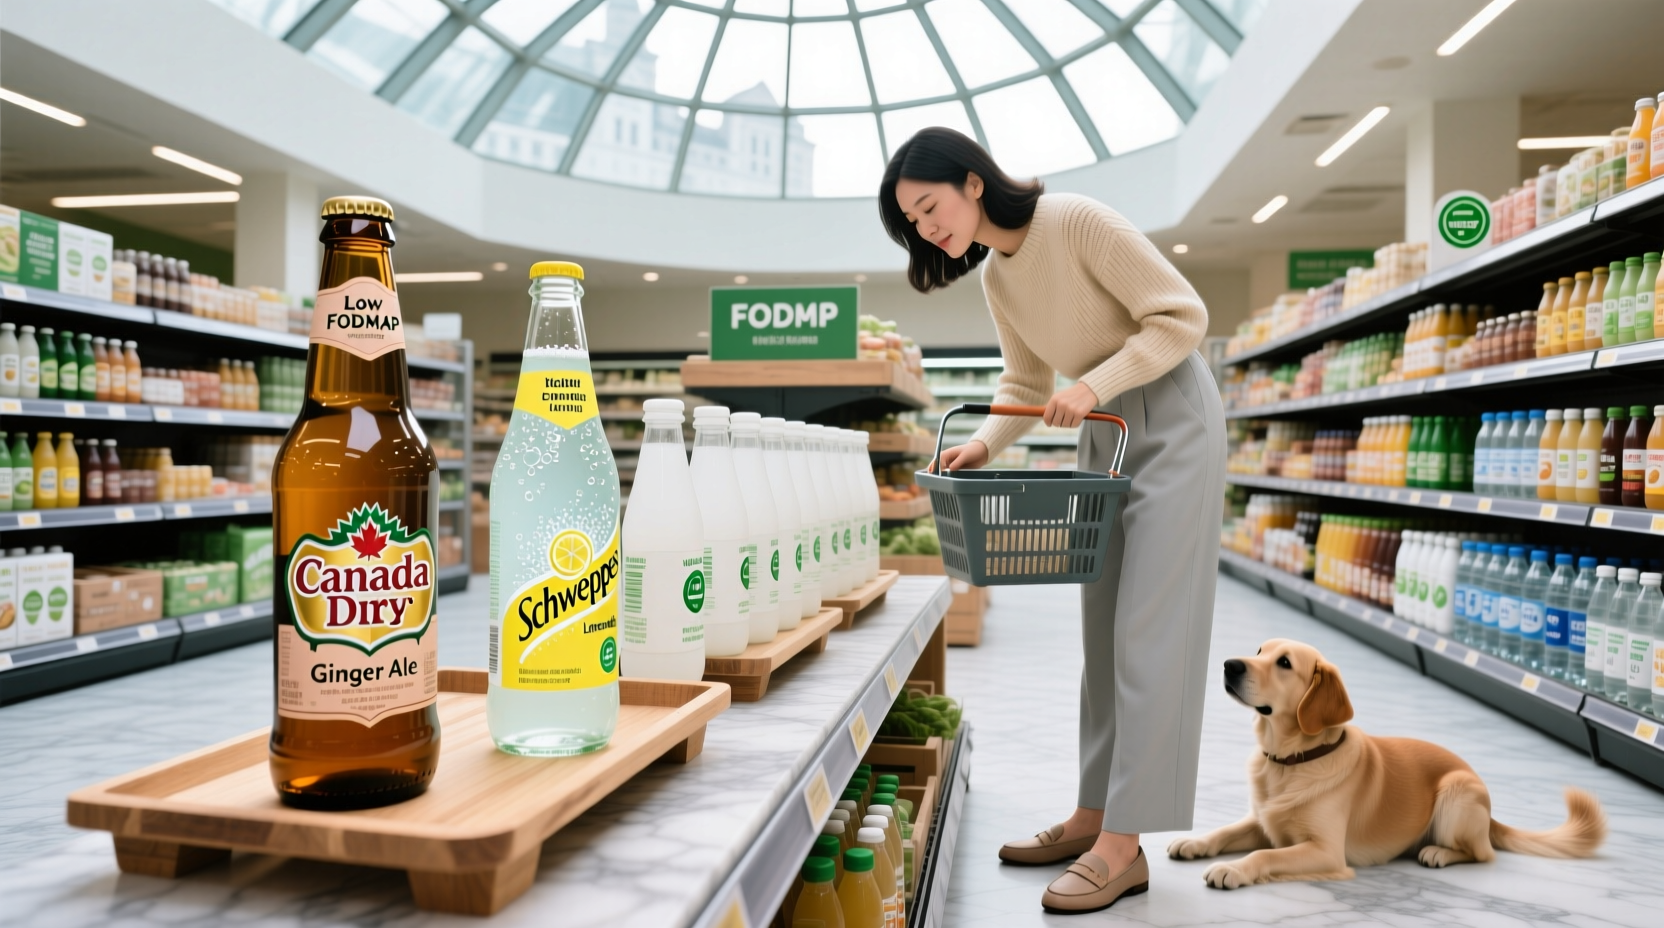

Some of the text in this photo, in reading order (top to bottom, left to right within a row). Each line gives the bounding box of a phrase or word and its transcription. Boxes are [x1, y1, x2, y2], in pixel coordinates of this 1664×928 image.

[344, 295, 383, 311] Low
[730, 301, 839, 330] FODMP
[326, 313, 400, 331] FODMAP
[295, 553, 429, 595] Canada
[310, 663, 385, 688] Ginger
[388, 656, 418, 679] Ale
